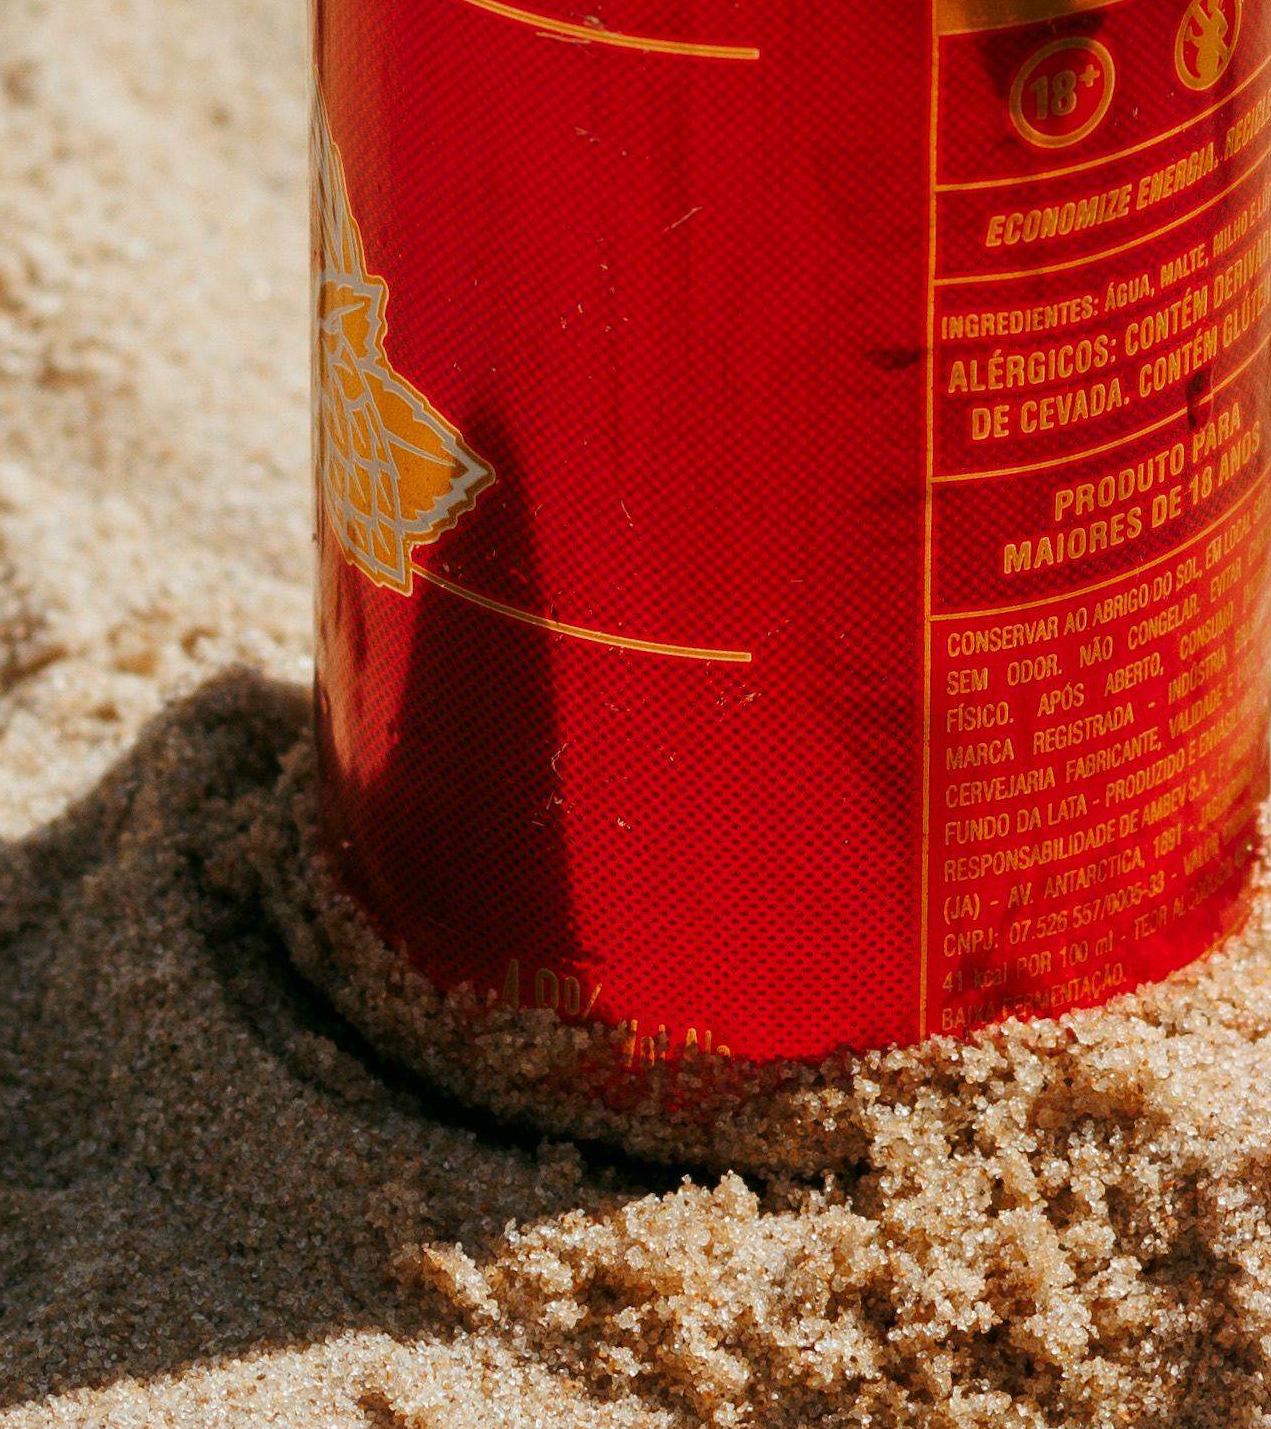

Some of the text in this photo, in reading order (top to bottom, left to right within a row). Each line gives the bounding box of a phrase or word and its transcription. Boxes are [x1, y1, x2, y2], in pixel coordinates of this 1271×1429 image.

[1028, 63, 1101, 120] 18+
[985, 184, 1132, 248] ECONOMIZE
[1136, 142, 1219, 210] ENERGIA.
[941, 294, 1099, 341] INGREDIENTES:
[1104, 273, 1155, 314] ÁGUA,
[1159, 242, 1210, 289] MALTE,
[1212, 214, 1249, 260] MILHO
[947, 333, 1117, 394] ALÉRGICOS:
[1124, 283, 1209, 357] CONTÉM
[971, 404, 1010, 441] DE
[1020, 377, 1131, 435] CEVADA.
[1139, 324, 1218, 399] CONTÉM
[1002, 420, 1260, 575] MAIORES DE 18 ANOS
[1054, 402, 1241, 522] PRODUTO PARA
[946, 615, 1060, 658] CONSERVAR
[1063, 606, 1088, 636] AO
[1092, 583, 1149, 628] ABRIGO
[1152, 571, 1173, 603] DO
[1175, 555, 1203, 593] SOL,
[1205, 533, 1223, 571] EM
[946, 667, 988, 696] SEM
[1006, 653, 1063, 686] ODOR.
[1079, 635, 1114, 669] NÃO
[1127, 592, 1201, 651] CONGELAR.
[1209, 555, 1243, 604] EVITAR
[945, 737, 1015, 771] MARCA
[1032, 701, 1135, 756] REGISTRADA
[1167, 643, 1228, 706] INDÚSTRIA
[946, 701, 1015, 733] FÍSICO.
[1037, 680, 1085, 718] APÓS
[1103, 651, 1164, 698] ABERTO,
[1179, 600, 1235, 661] CONSUMO
[944, 765, 1056, 809] CERVEJARIA
[1065, 726, 1162, 784] FABRICANTE,
[1168, 683, 1223, 739] VALIDADE
[944, 812, 1010, 846] FUNDO
[1016, 806, 1041, 834] DA
[1047, 792, 1088, 826] LATA
[1105, 747, 1186, 808] PRODUZIDO
[943, 892, 981, 926] (JA)
[1007, 882, 1034, 909] AV.
[1043, 846, 1146, 900] ANTARCTICA,
[944, 818, 1116, 883] RESPONSABILIDADE
[1119, 809, 1139, 838] DE
[1141, 782, 1187, 828] AMBEV
[941, 971, 963, 993] 41
[1016, 950, 1052, 980] POR
[1059, 939, 1089, 968] 100
[1095, 929, 1114, 957] ml
[943, 927, 1000, 958] CNPJ:
